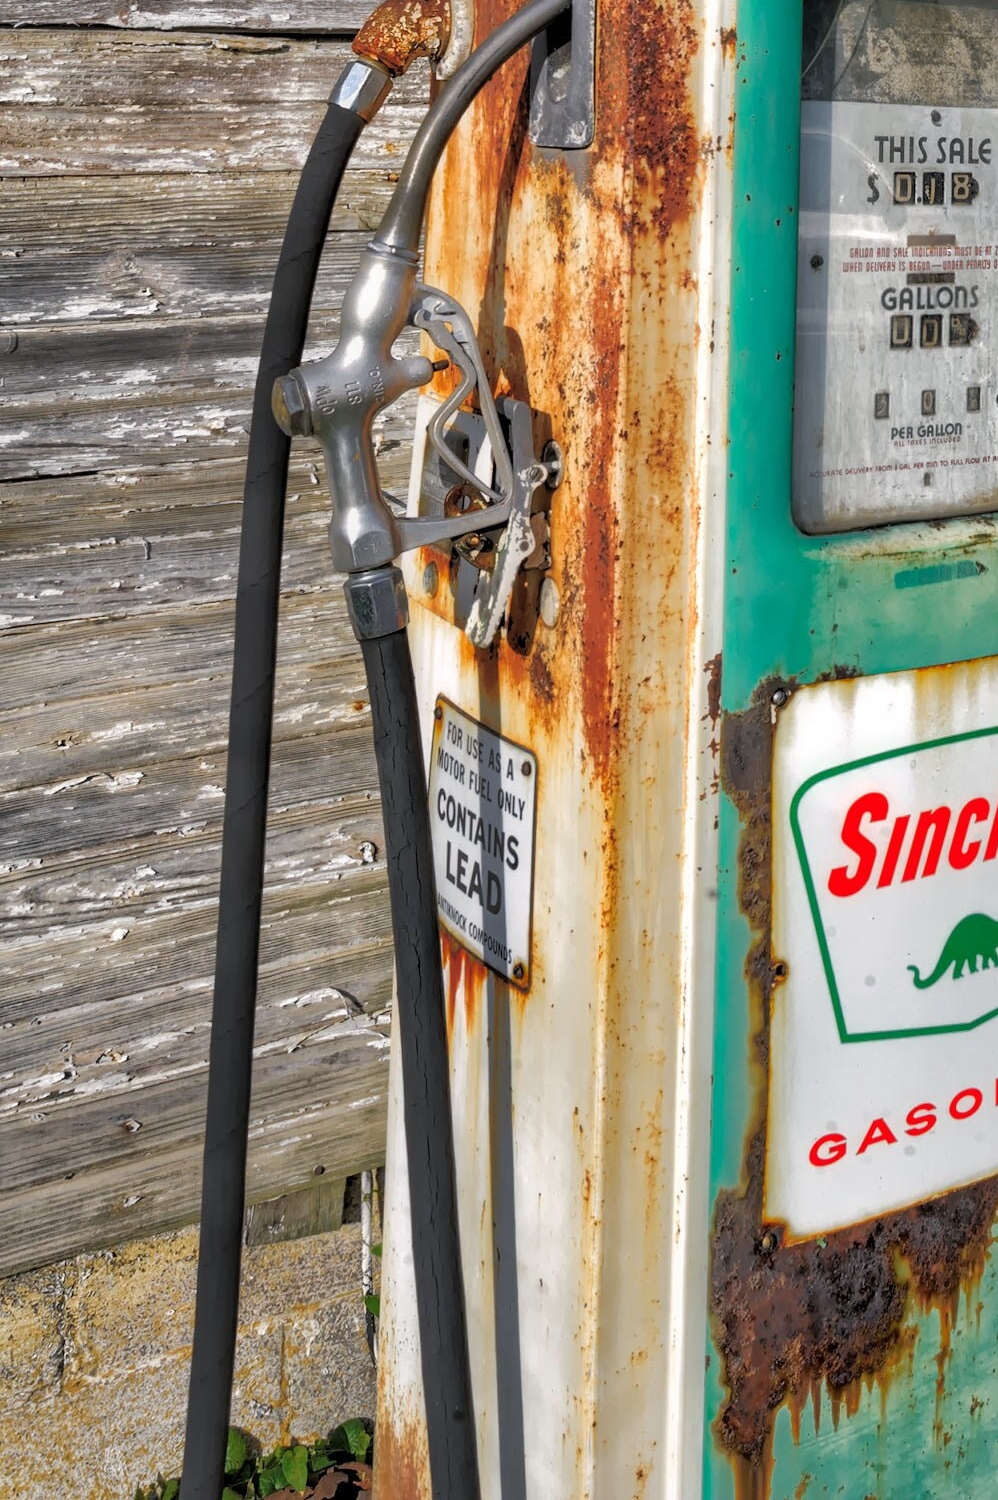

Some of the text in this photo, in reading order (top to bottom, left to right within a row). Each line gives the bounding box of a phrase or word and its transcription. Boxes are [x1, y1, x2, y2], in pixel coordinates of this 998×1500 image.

[873, 135, 992, 165] THIS SALE
[849, 247, 874, 258] GALLON
[876, 247, 890, 258] AND
[893, 247, 909, 258] SALE
[974, 245, 983, 257] BE
[984, 245, 992, 256] AT
[842, 261, 863, 273] WHEN
[865, 261, 896, 273] DELIVERY
[966, 259, 991, 270] PENALTY
[881, 284, 979, 311] GALLONS
[890, 422, 963, 440] PER GALLON
[893, 436, 962, 448] ALL TAXES INCLUDED
[845, 466, 873, 476] DELIVERY
[875, 464, 893, 473] FROM
[913, 461, 924, 470] PER
[950, 458, 964, 466] FULL
[965, 457, 981, 465] FLOW
[982, 455, 991, 463] AT
[446, 721, 514, 781] FOR USE AS A
[437, 746, 526, 822] MOTOR FUEL ONLY
[437, 787, 520, 871] CONTAINS
[445, 840, 502, 916] LEAD
[437, 892, 512, 964] ANTIKNOCK COMPOUNDS
